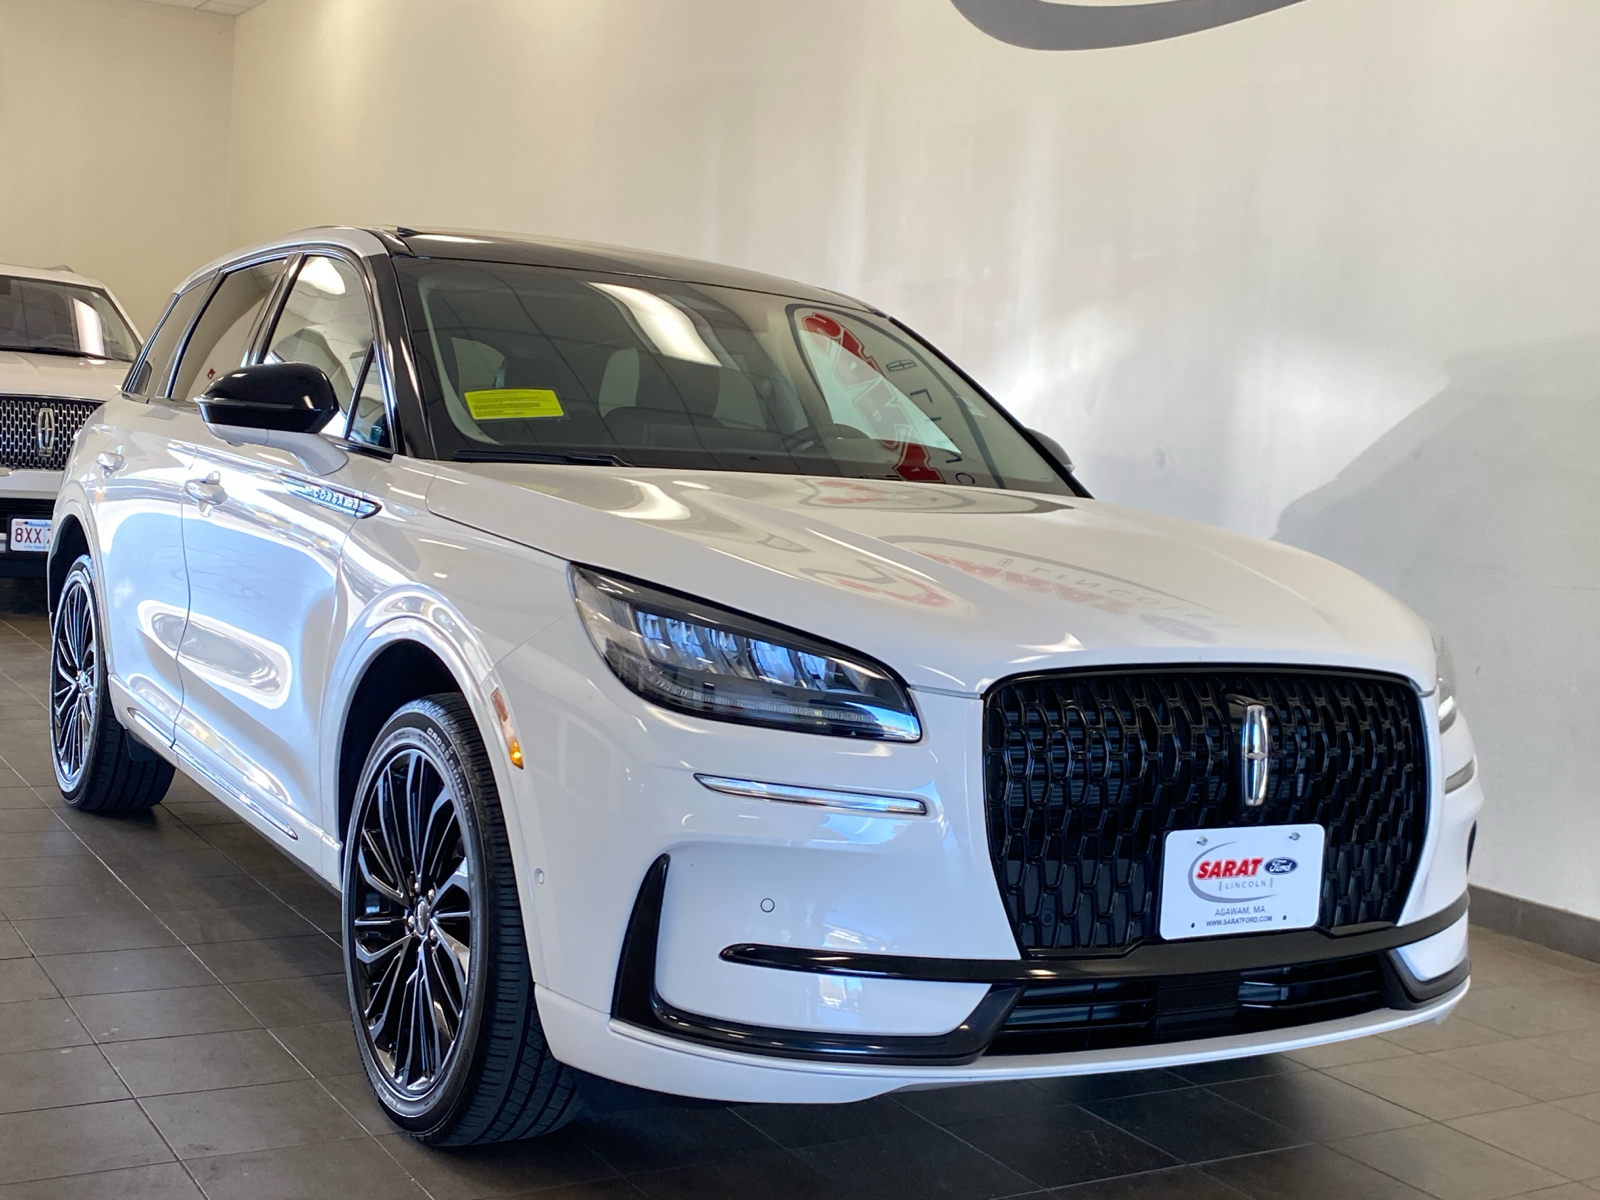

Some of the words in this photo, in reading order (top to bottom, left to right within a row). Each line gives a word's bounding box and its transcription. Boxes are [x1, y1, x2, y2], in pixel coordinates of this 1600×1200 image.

[1196, 857, 1264, 880] SARAT
[1269, 860, 1293, 872] Ford
[1225, 881, 1266, 889] LINCOLN
[1215, 906, 1251, 916] AGAWAM,
[1254, 905, 1265, 914] MA
[1206, 916, 1272, 926] WWW.SARATFORD.COM
